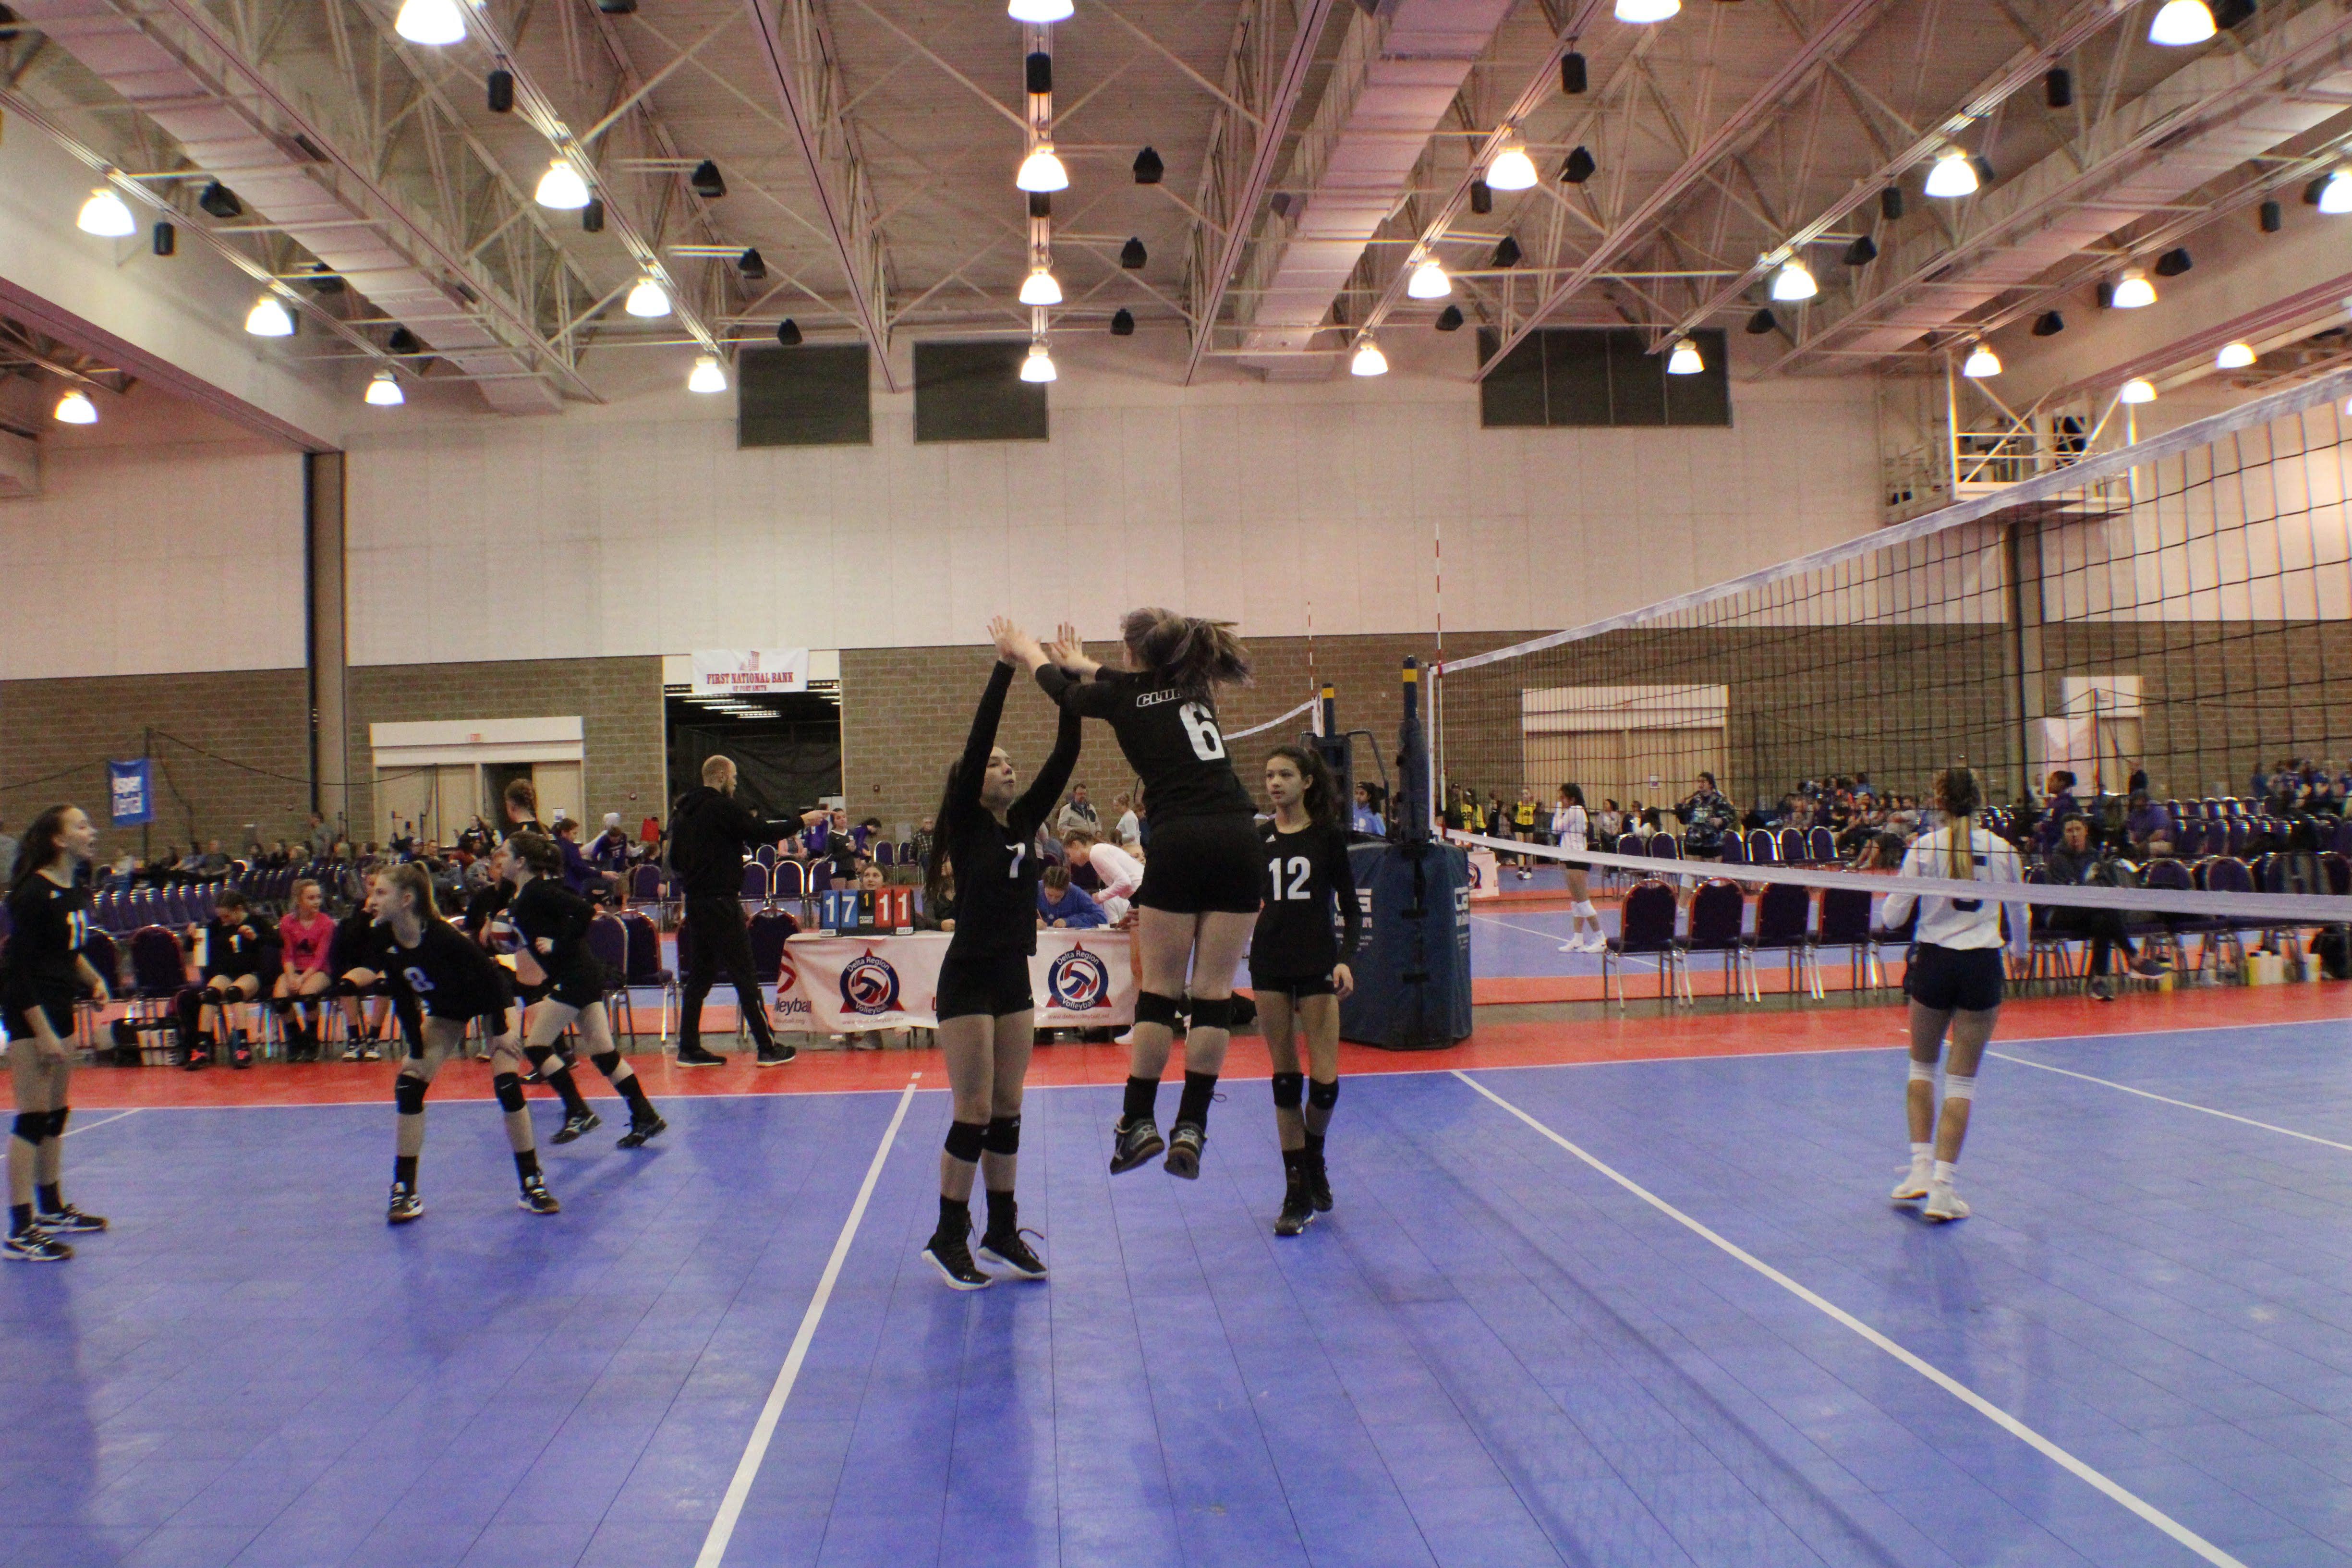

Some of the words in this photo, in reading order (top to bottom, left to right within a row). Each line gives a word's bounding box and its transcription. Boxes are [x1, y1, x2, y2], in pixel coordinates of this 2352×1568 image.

[707, 674, 729, 684] FIRST
[731, 673, 770, 683] NATIONAL
[772, 672, 793, 683] BANK
[1179, 702, 1225, 761] 6
[1006, 842, 1025, 878] 7
[1268, 856, 1310, 900] 12
[864, 893, 869, 907] 1
[847, 959, 865, 972] Delta
[866, 956, 890, 971] Region
[1056, 952, 1075, 966] Delta
[1076, 950, 1100, 965] Region
[775, 997, 812, 1016] lleyball
[855, 1002, 889, 1015] Volleyb
[1062, 997, 1096, 1011] Volleyball
